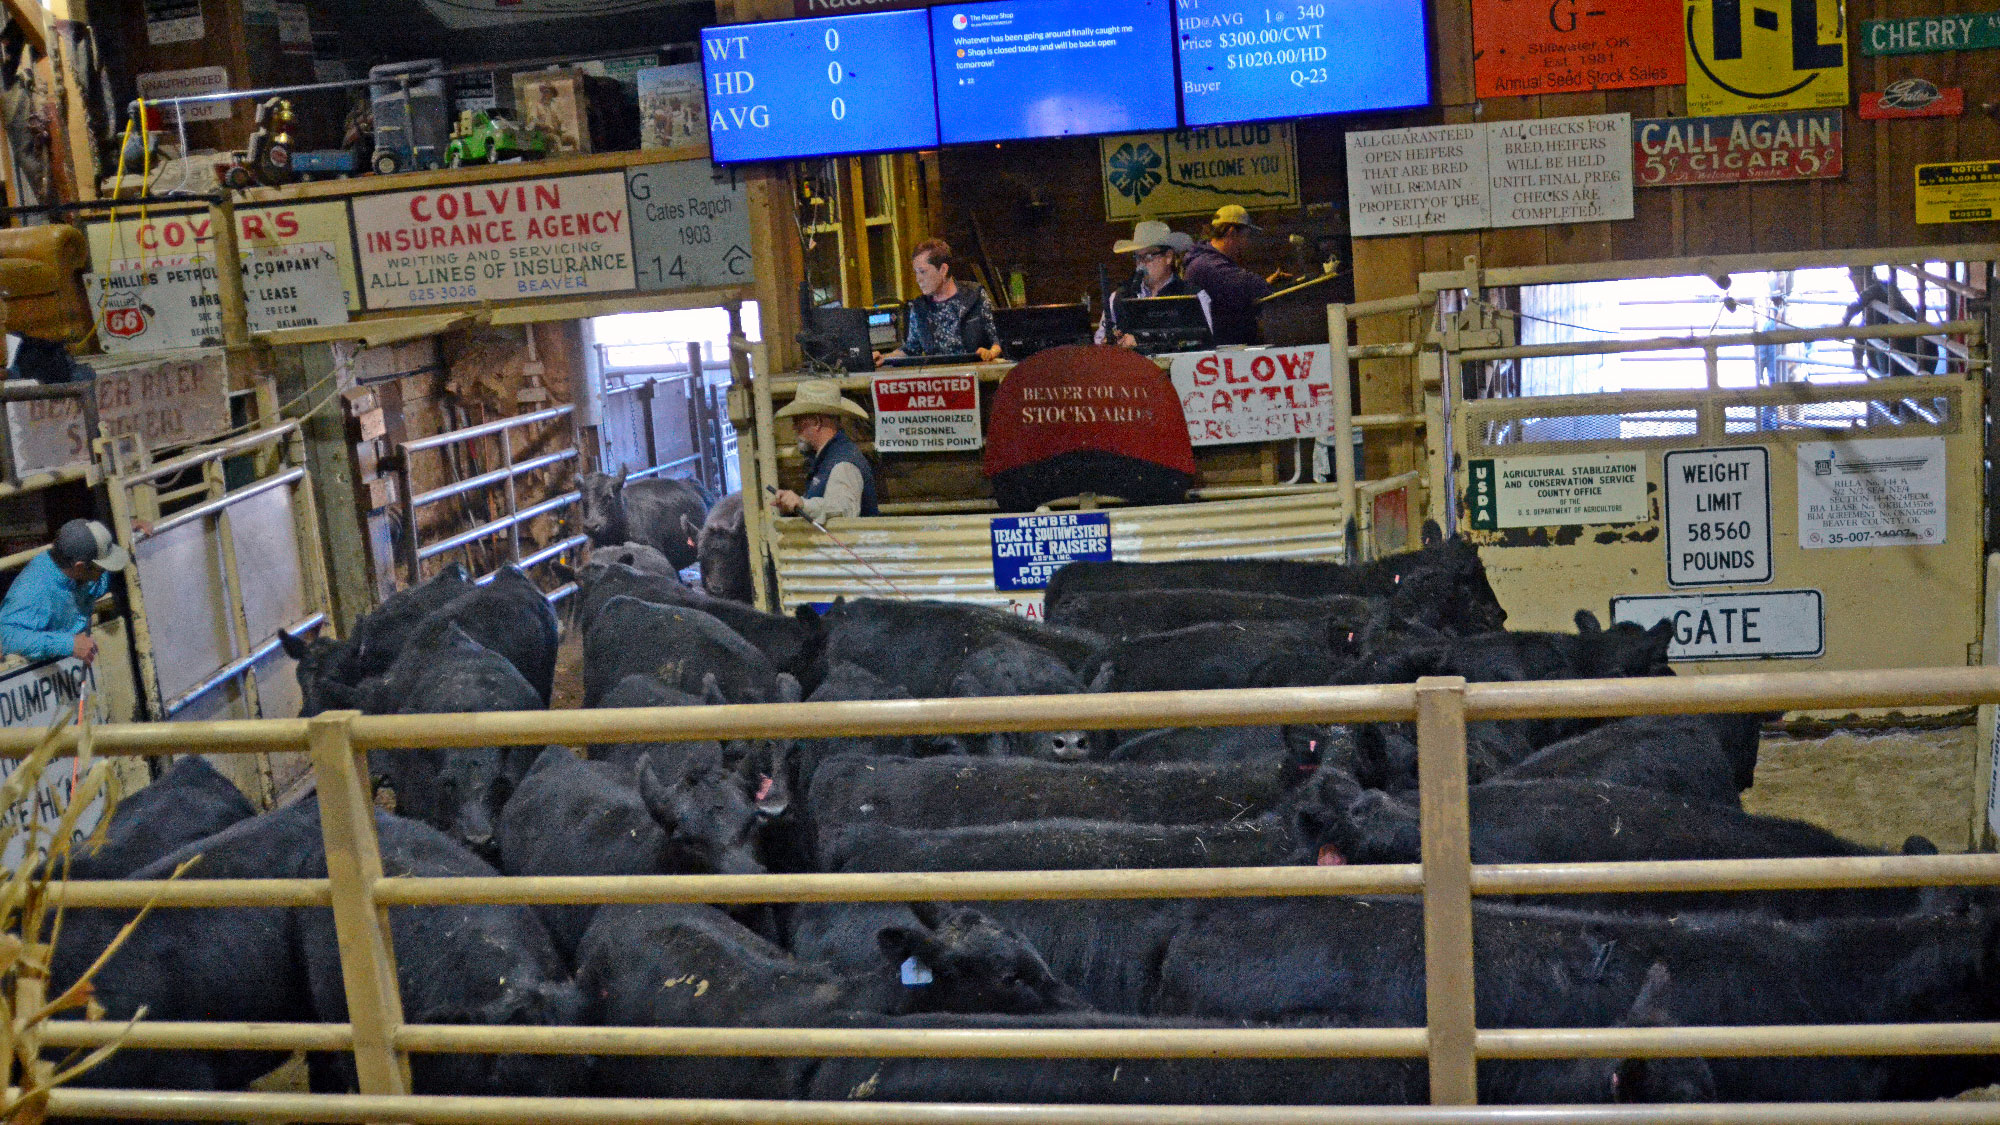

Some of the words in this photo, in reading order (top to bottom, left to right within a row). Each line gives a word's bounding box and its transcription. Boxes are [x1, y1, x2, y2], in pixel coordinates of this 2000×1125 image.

[1179, 12, 1243, 31] HD@AVG
[1297, 4, 1325, 21] 340
[953, 36, 990, 46] Whatever
[991, 34, 1003, 42] has
[1004, 33, 1023, 42] been
[1023, 31, 1044, 41] going
[1044, 29, 1071, 39] around
[1071, 27, 1094, 36] finally
[1095, 25, 1120, 35] caught
[1219, 24, 1324, 48] $300.00/CWT
[1871, 18, 1974, 50] CHERRY
[706, 36, 749, 61] WT
[825, 28, 839, 51] 0
[967, 48, 986, 57] Shop
[986, 47, 993, 55] is
[993, 45, 1017, 55] closed
[1018, 44, 1039, 53] today
[1039, 42, 1054, 51] and
[1054, 41, 1068, 50] will
[1068, 40, 1079, 49] be
[1079, 39, 1097, 48] back
[1097, 39, 1116, 48] open
[956, 59, 995, 70] tomorrow!
[1227, 46, 1327, 69] $1020.00/HD
[713, 71, 754, 95] HD
[827, 61, 842, 84] 0
[1184, 80, 1221, 95] Buyer
[1290, 68, 1328, 87] Q-23
[1495, 75, 1542, 91] Annual
[1546, 72, 1582, 87] Seed
[1587, 68, 1625, 85] Stock
[1630, 65, 1668, 81] Sales
[711, 105, 769, 131] AVG
[831, 97, 846, 120] 0
[1354, 136, 1380, 148] ALL
[1381, 128, 1474, 146] GUARANTEED
[1500, 126, 1525, 138] ALL
[1528, 122, 1584, 136] CHECKS
[1588, 119, 1617, 133] FOR
[1641, 123, 1717, 155] CALL
[1728, 117, 1830, 150] AGAIN
[1365, 150, 1401, 164] OPEN
[1406, 146, 1463, 161] HEIFERS
[1505, 142, 1542, 155] BRED
[1544, 138, 1606, 153] HEIFERS
[1178, 158, 1245, 180] WELCOME
[1250, 155, 1279, 175] YOU
[1506, 158, 1542, 171] WILL
[1545, 156, 1564, 169] BE
[1567, 154, 1605, 167] HELD
[1689, 151, 1789, 170] CIGAR
[1362, 166, 1398, 181] THAT
[1401, 164, 1429, 178] ARE
[1432, 162, 1468, 175] BRED
[1538, 172, 1580, 186] FINAL
[1584, 170, 1621, 184] PREG
[1371, 182, 1405, 196] WILL
[1408, 178, 1462, 193] REMAIN
[1514, 190, 1568, 204] CHECKS
[1572, 188, 1599, 201] ARE
[410, 184, 561, 222] COLVIN
[646, 202, 685, 222] Cates
[688, 195, 732, 216] Ranch
[1358, 198, 1428, 214] PROPERTY
[1430, 196, 1447, 209] OF
[1450, 193, 1480, 207] THE
[1512, 205, 1601, 220] COMPLETED!
[1392, 213, 1446, 228] SELLER!
[367, 220, 516, 254] INSURANCE
[527, 210, 622, 240] AGENCY
[678, 225, 711, 245] 1903
[387, 253, 458, 268] WRITING
[467, 250, 499, 262] AND
[510, 242, 602, 259] SERVICING
[255, 257, 319, 274] COMPANY
[370, 272, 409, 288] ALL
[416, 265, 476, 284] LINES
[484, 262, 506, 278] OF
[514, 253, 628, 276] INSURANCE
[260, 286, 297, 301] LEASE
[518, 276, 588, 293] BEAVER
[111, 311, 138, 330] 66
[276, 318, 318, 329] OKLAHOMA
[1192, 351, 1315, 387] SLOW
[879, 378, 971, 394] RESTRICTED
[1023, 386, 1082, 400] BEAVER
[907, 395, 946, 408] AREA
[1183, 383, 1333, 414] CATTLE
[881, 416, 895, 424] NO
[898, 414, 973, 424] UNAUTHORIZED
[899, 426, 956, 435] PERSONNEL
[880, 439, 919, 447] BEYOND
[922, 438, 944, 446] THIS
[947, 437, 977, 446] POINT
[1503, 467, 1566, 479] AGRICULTURAL
[1572, 464, 1637, 476] STABILIZATION
[1682, 462, 1750, 483] WEIGHT
[1504, 480, 1522, 489] AND
[1528, 477, 1594, 488] CONSERVATION
[1599, 475, 1635, 485] SERVICE
[1476, 467, 1490, 521] USDA
[1537, 489, 1570, 498] COUNTY
[1573, 487, 1602, 496] OFFICE
[1696, 492, 1742, 512] LIMIT
[1830, 495, 1869, 504] SECTION
[1533, 507, 1571, 516] DEPARTMENT
[1583, 505, 1622, 513] AGRICULTURE
[1810, 505, 1826, 513] BIA
[1830, 503, 1857, 511] LEASE
[1827, 510, 1875, 520] AGREEMENT
[1018, 515, 1078, 528] MEMBER
[1822, 519, 1858, 528] BEAVER
[994, 528, 1023, 543] TEXAS
[1025, 528, 1033, 541] &
[1034, 523, 1108, 541] SOUTHWESTERN
[997, 541, 1045, 558] CATTLE
[1048, 538, 1107, 554] RAISERS
[1683, 550, 1755, 571] POUNDS
[1673, 607, 1761, 645] GATE
